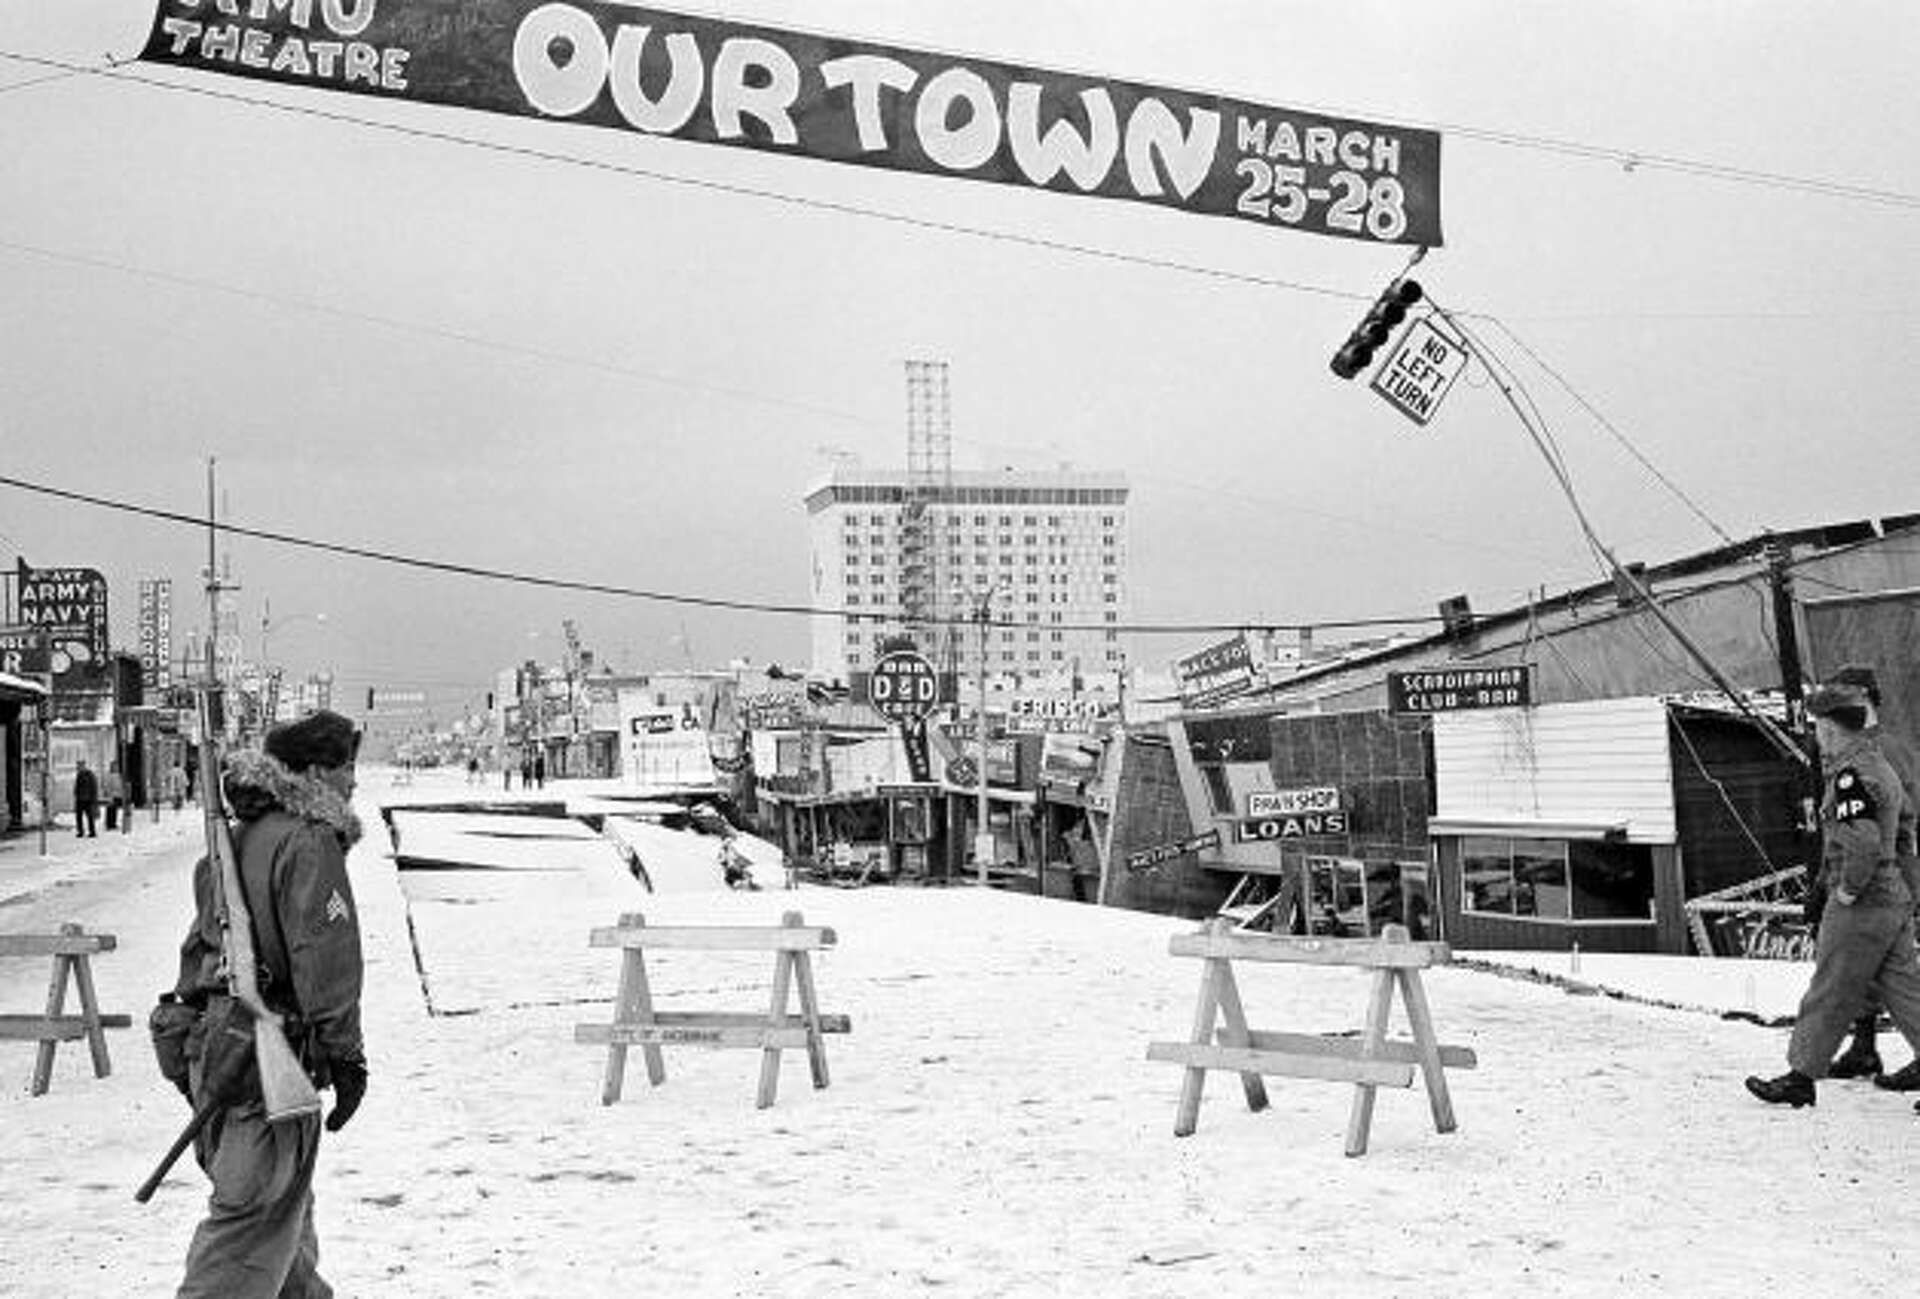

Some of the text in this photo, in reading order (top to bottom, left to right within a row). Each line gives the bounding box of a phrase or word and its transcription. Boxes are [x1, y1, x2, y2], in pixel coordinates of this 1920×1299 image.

[178, 0, 376, 36] MU
[163, 17, 410, 90] THEATRE
[513, 2, 1221, 200] OUR TOWN
[1238, 116, 1400, 174] MARCH
[1235, 158, 1407, 240] 25-28
[1421, 336, 1447, 364] NO
[1397, 348, 1444, 392] LEFT
[1385, 369, 1434, 415] TURN
[22, 583, 90, 601] ARMY
[23, 604, 90, 623] NAVY
[1408, 693, 1457, 709] CLUB
[1479, 689, 1519, 704] BAR
[1241, 815, 1343, 840] LOANS
[1836, 800, 1865, 819] MP
